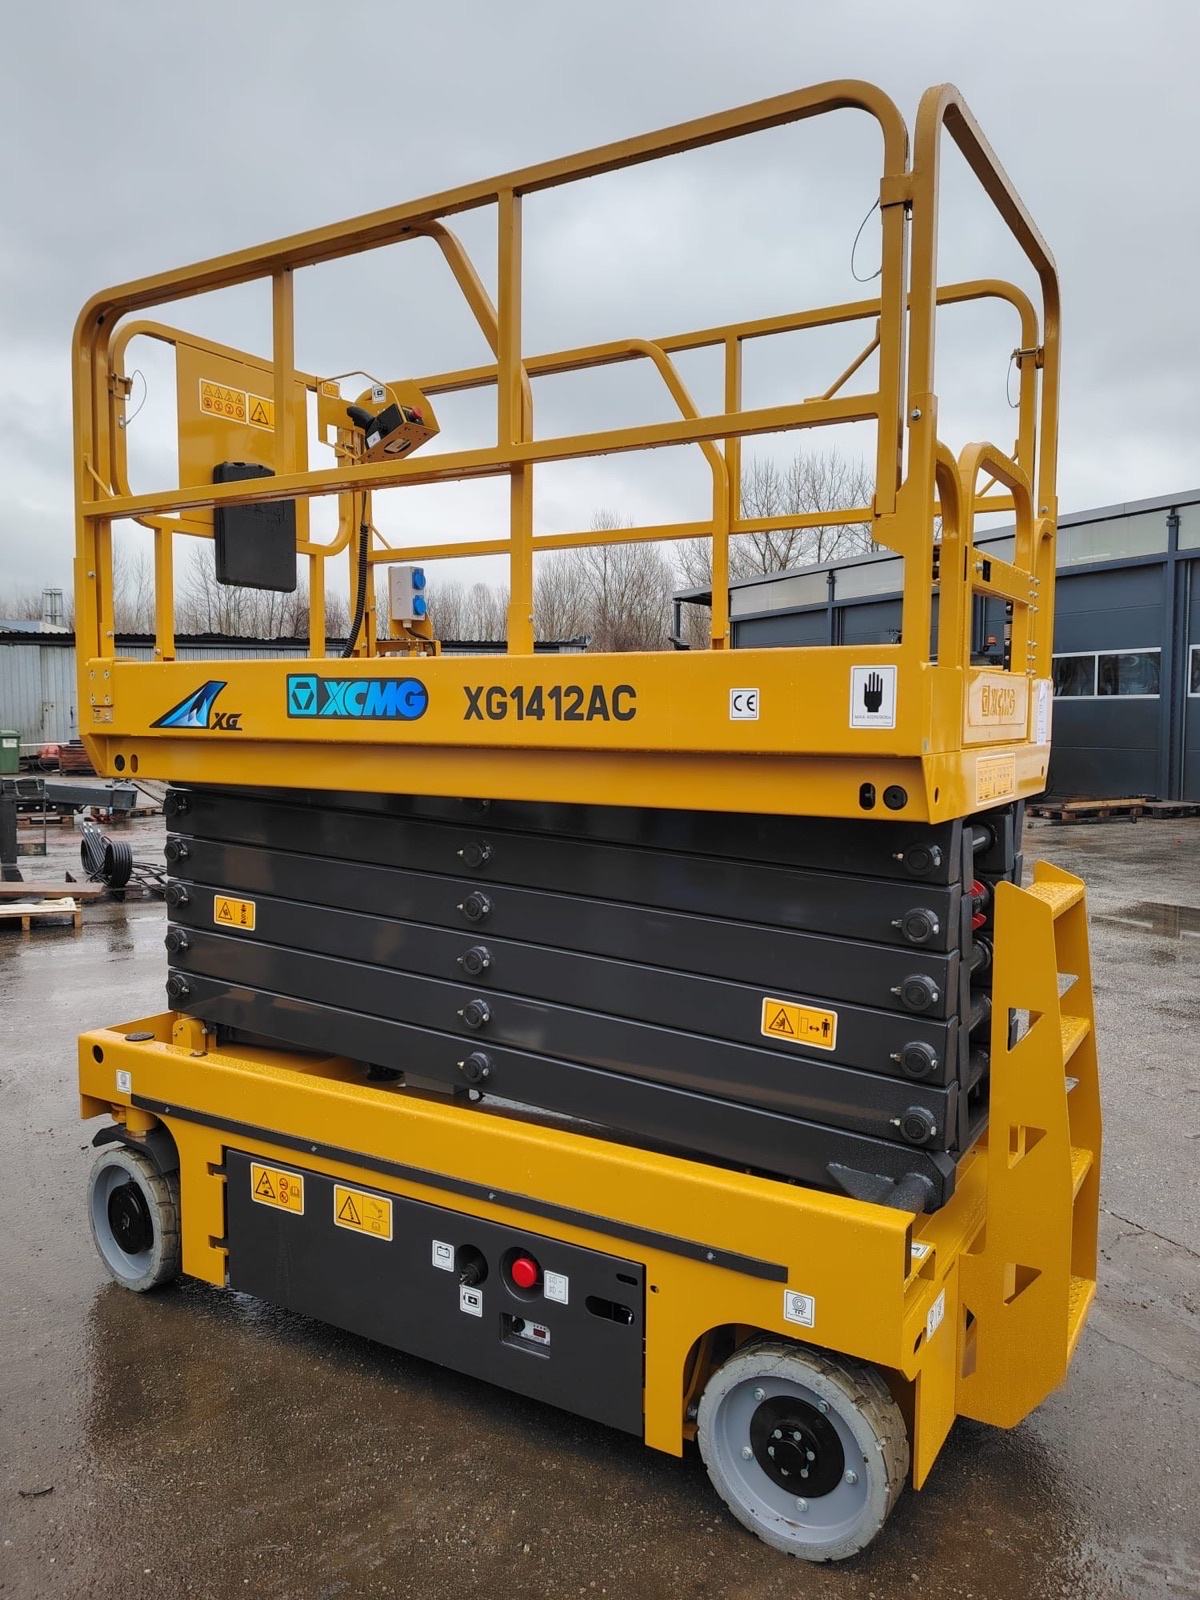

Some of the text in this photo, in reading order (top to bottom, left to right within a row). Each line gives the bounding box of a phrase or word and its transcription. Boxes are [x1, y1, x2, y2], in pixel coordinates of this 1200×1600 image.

[318, 680, 427, 718] XCMG
[463, 684, 637, 721] XG1412AC
[733, 694, 756, 712] CE
[210, 712, 243, 731] XG
